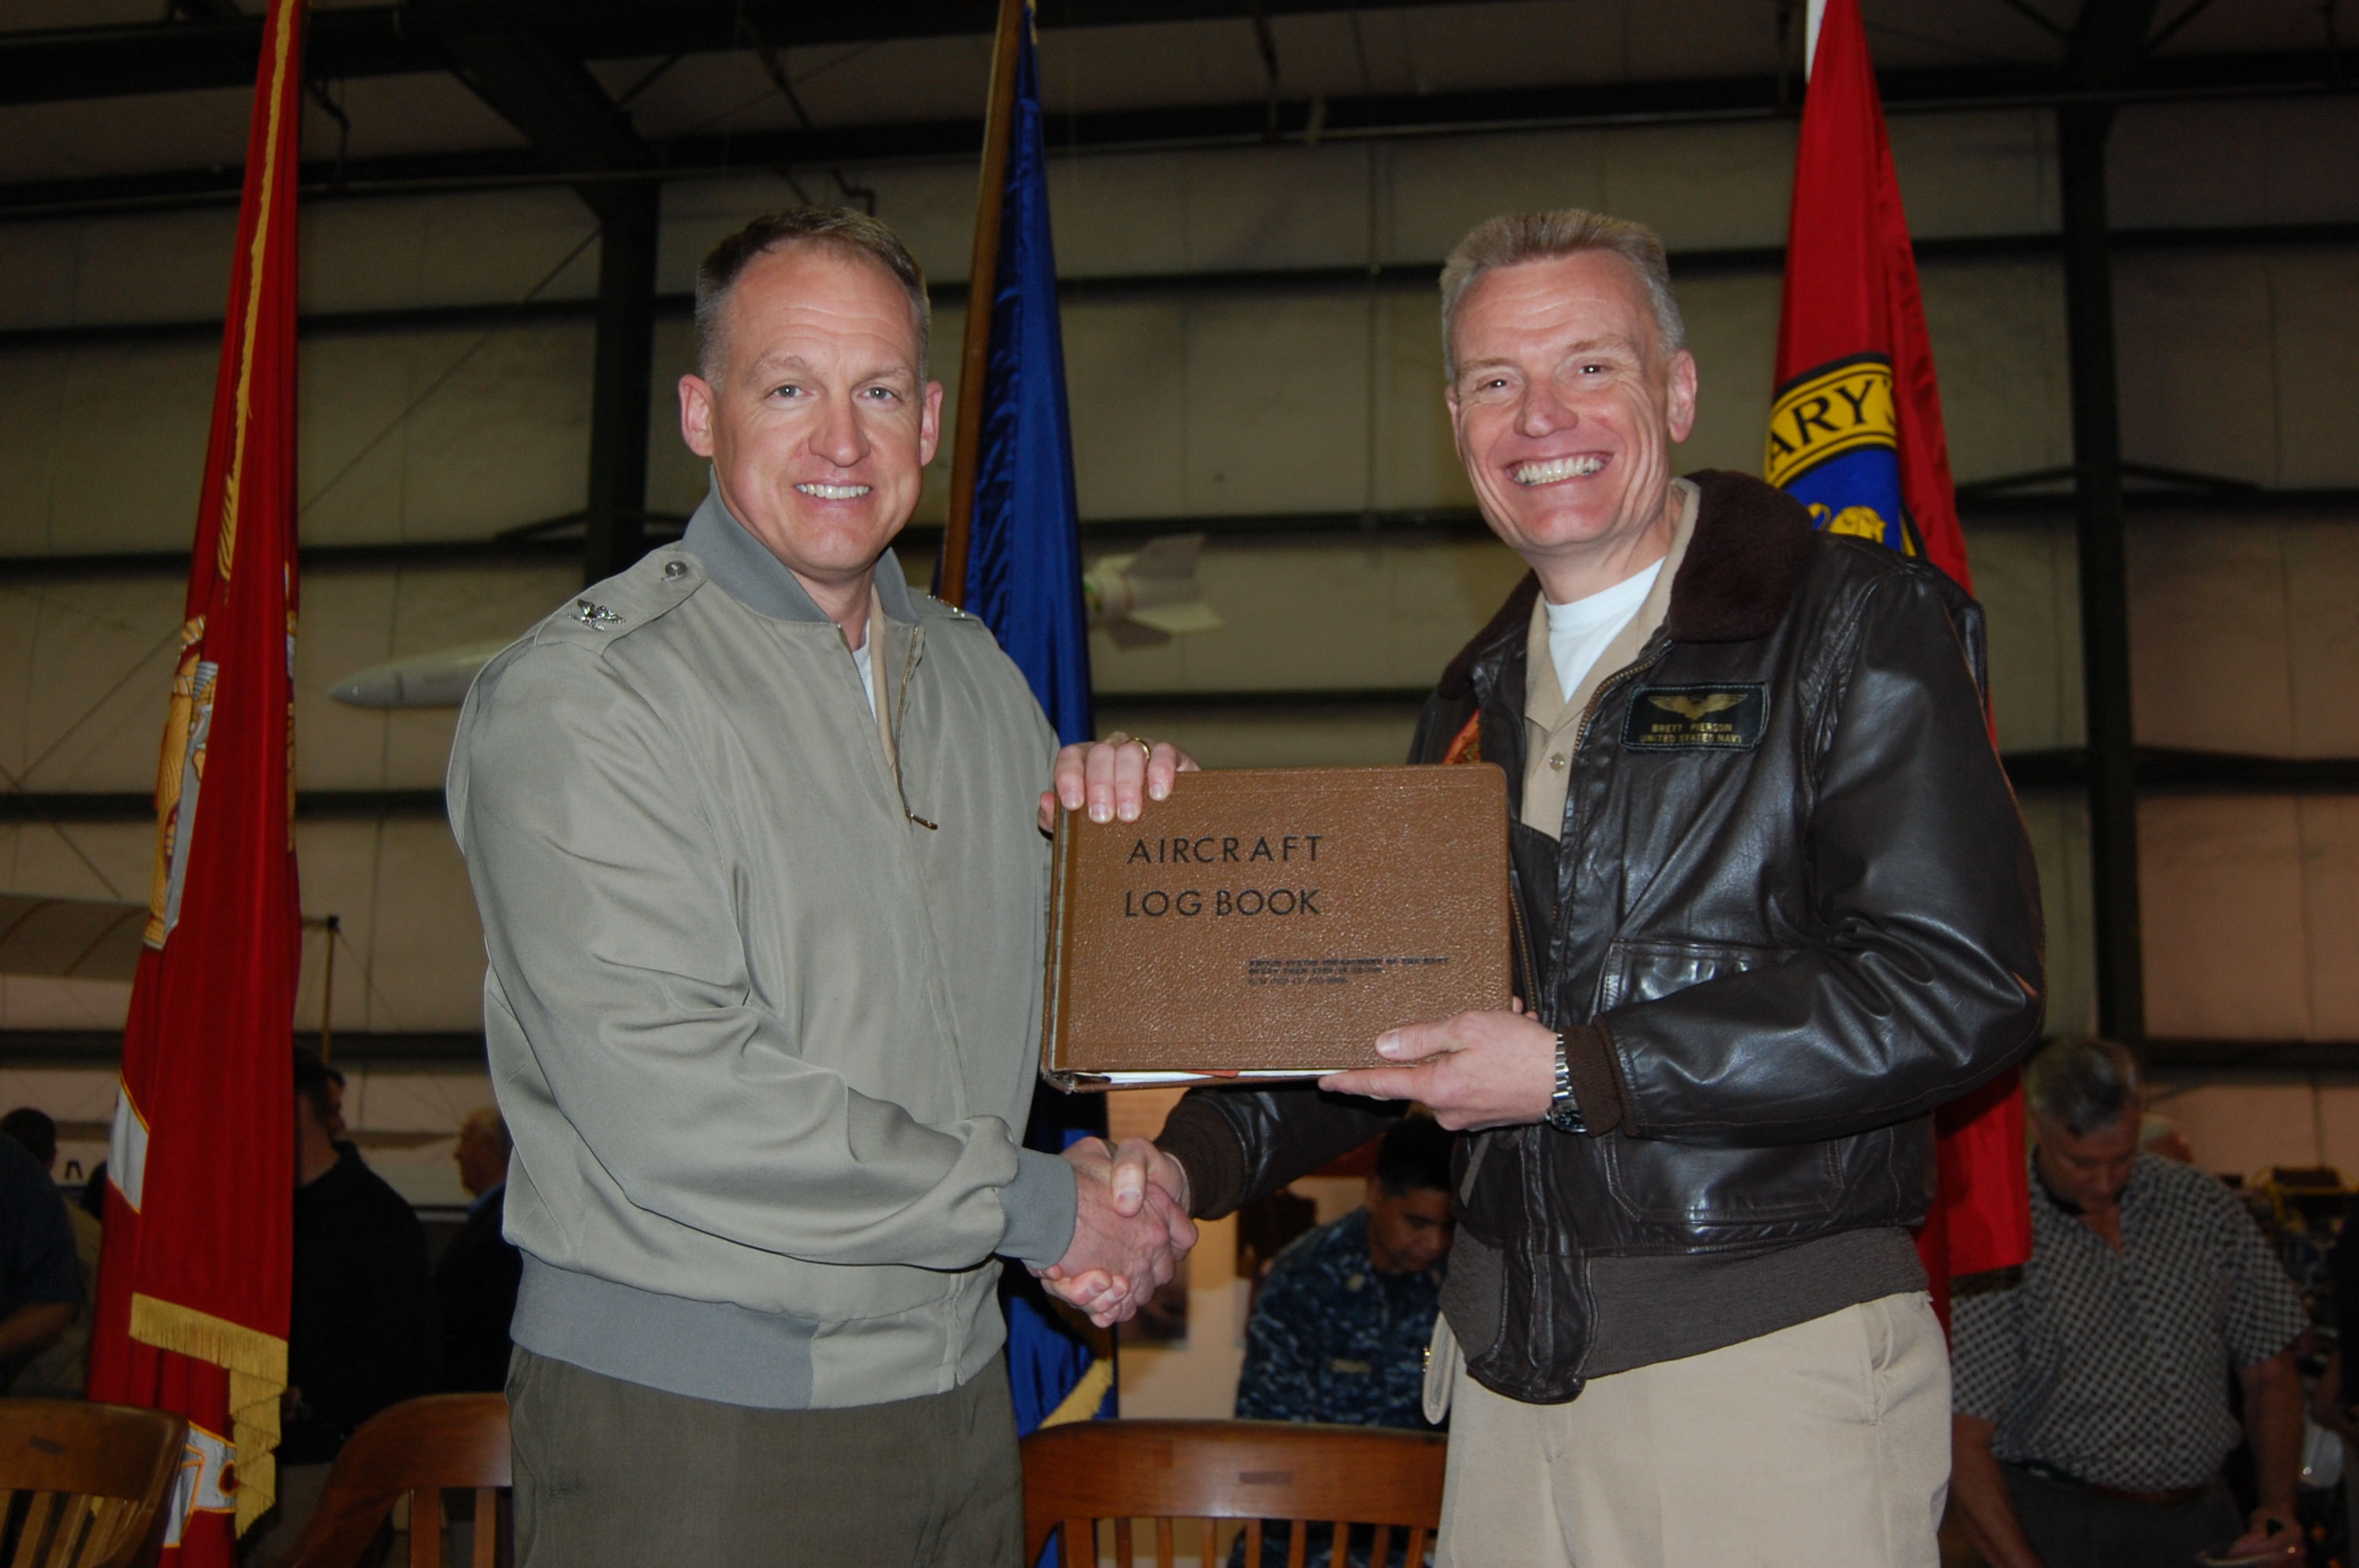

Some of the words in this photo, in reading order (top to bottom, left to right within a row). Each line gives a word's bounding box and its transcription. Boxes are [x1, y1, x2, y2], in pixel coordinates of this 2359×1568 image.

[1651, 724, 1683, 732] BRETT
[1690, 722, 1732, 732] PIERSON
[1678, 733, 1714, 743] STATES
[1126, 835, 1322, 864] AIRCRAFT
[1125, 890, 1202, 917] LOG
[1216, 887, 1321, 916] BOOK
